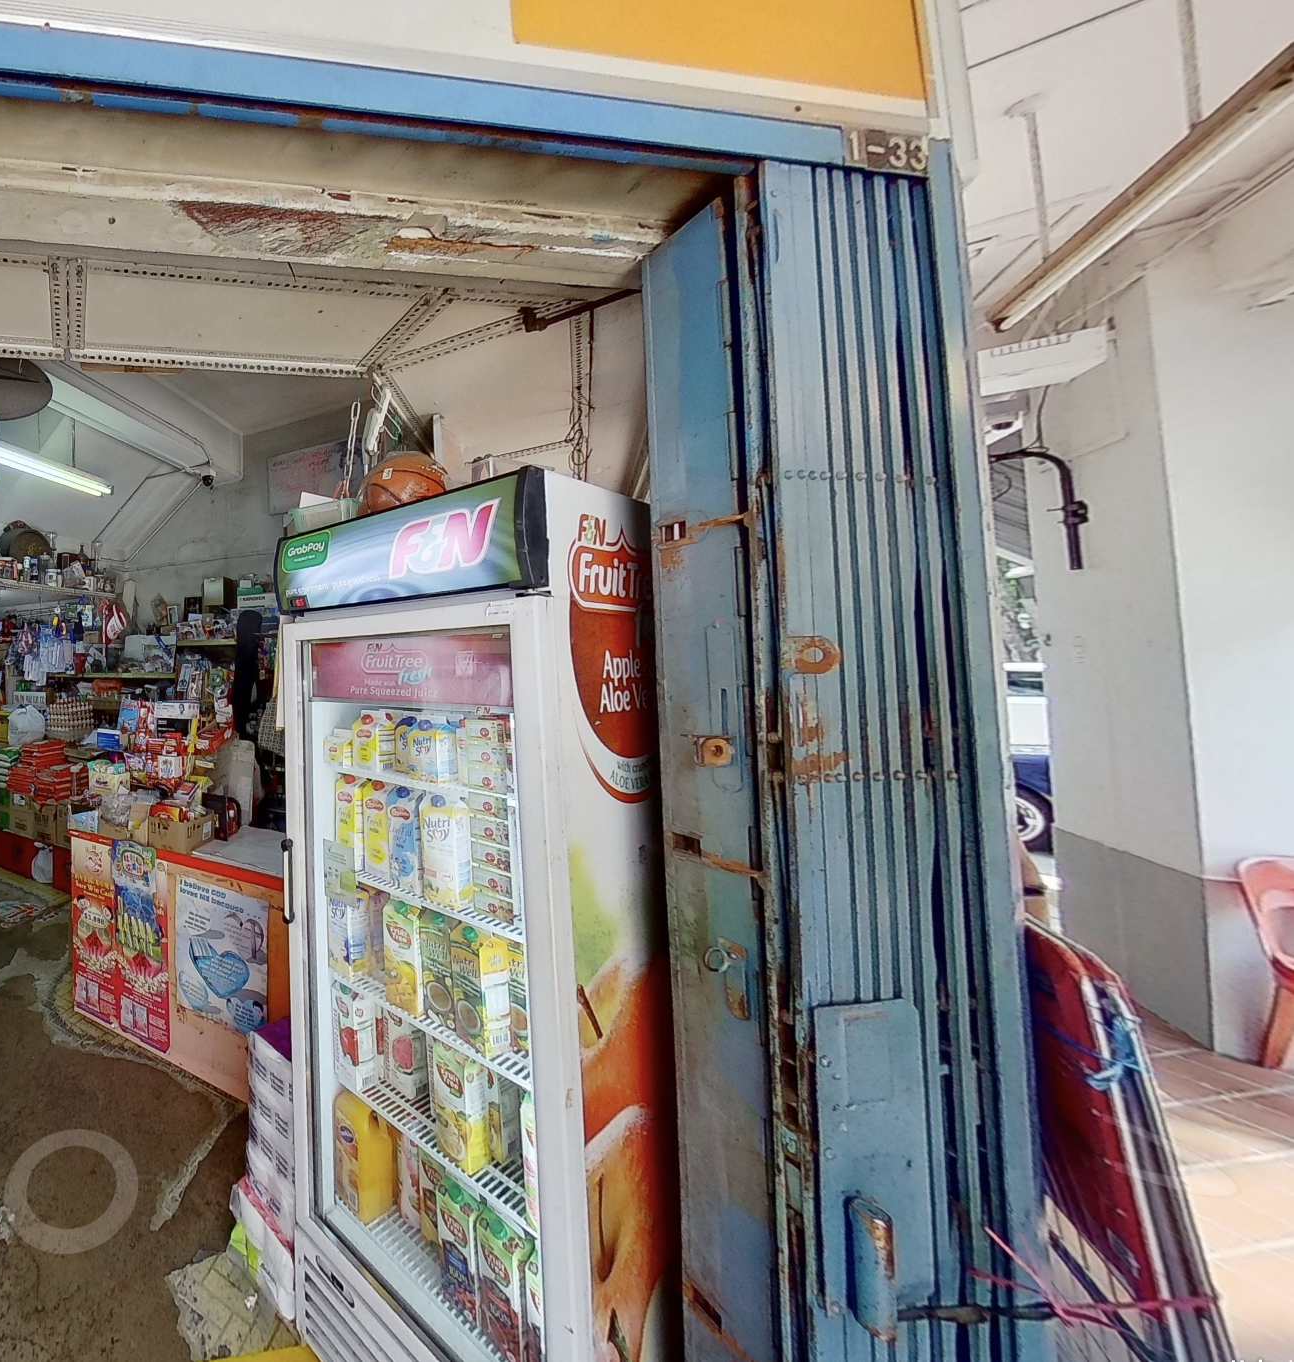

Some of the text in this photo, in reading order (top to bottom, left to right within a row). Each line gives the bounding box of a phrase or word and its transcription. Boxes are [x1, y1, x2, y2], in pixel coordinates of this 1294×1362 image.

[849, 130, 928, 171] 1-33
[389, 496, 502, 579] F&N
[578, 514, 606, 546] F&N
[287, 541, 326, 557] GrabPay
[346, 573, 381, 588] goodness
[603, 649, 641, 680] Apple
[398, 663, 433, 686] fresh
[350, 685, 440, 699] Pure Squeezed Juice
[599, 682, 631, 714] Aloe
[413, 736, 432, 748] Nutri
[609, 769, 629, 788] ALOE
[422, 816, 451, 829] Nutri
[86, 883, 100, 895] Win
[183, 880, 210, 894] believe
[211, 888, 226, 899] GOD
[179, 886, 198, 898] loves
[211, 896, 244, 914] because
[452, 953, 475, 967] Nutri
[458, 964, 481, 979] Well
[444, 1213, 464, 1231] Fruit
[484, 1247, 505, 1268] Fruit
